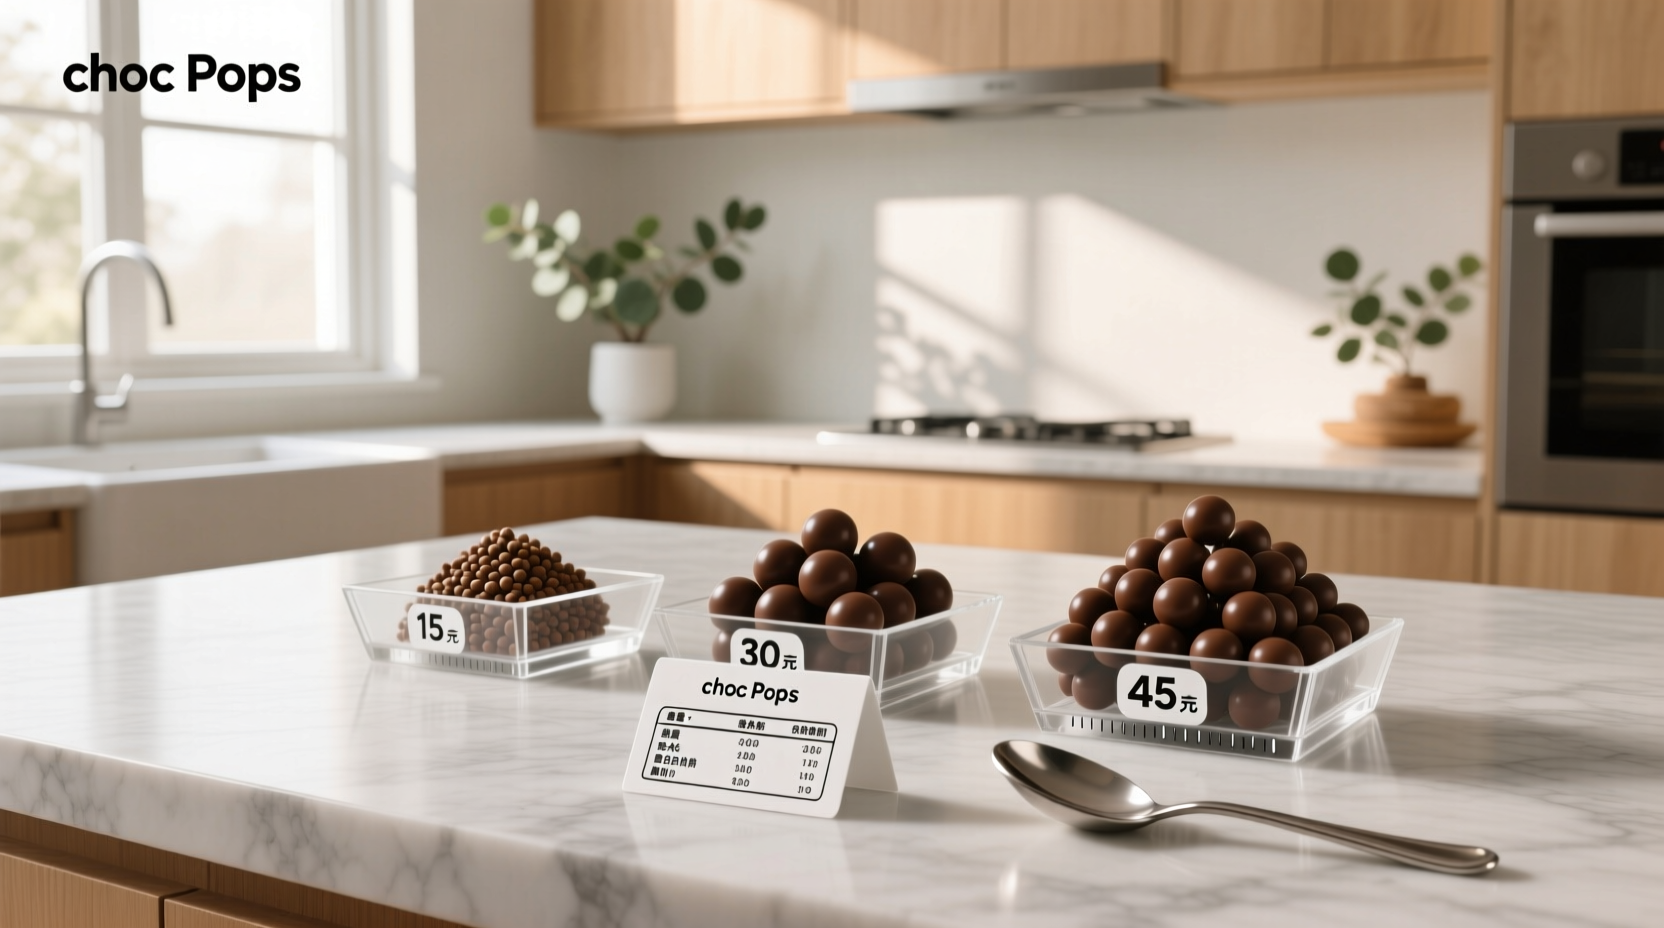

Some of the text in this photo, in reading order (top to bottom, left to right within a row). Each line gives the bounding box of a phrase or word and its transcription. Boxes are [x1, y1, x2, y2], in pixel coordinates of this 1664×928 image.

[416, 612, 459, 644] 15元
[740, 637, 797, 670] 30元
[702, 677, 799, 706] choc Pops
[1127, 674, 1198, 713] 45元
